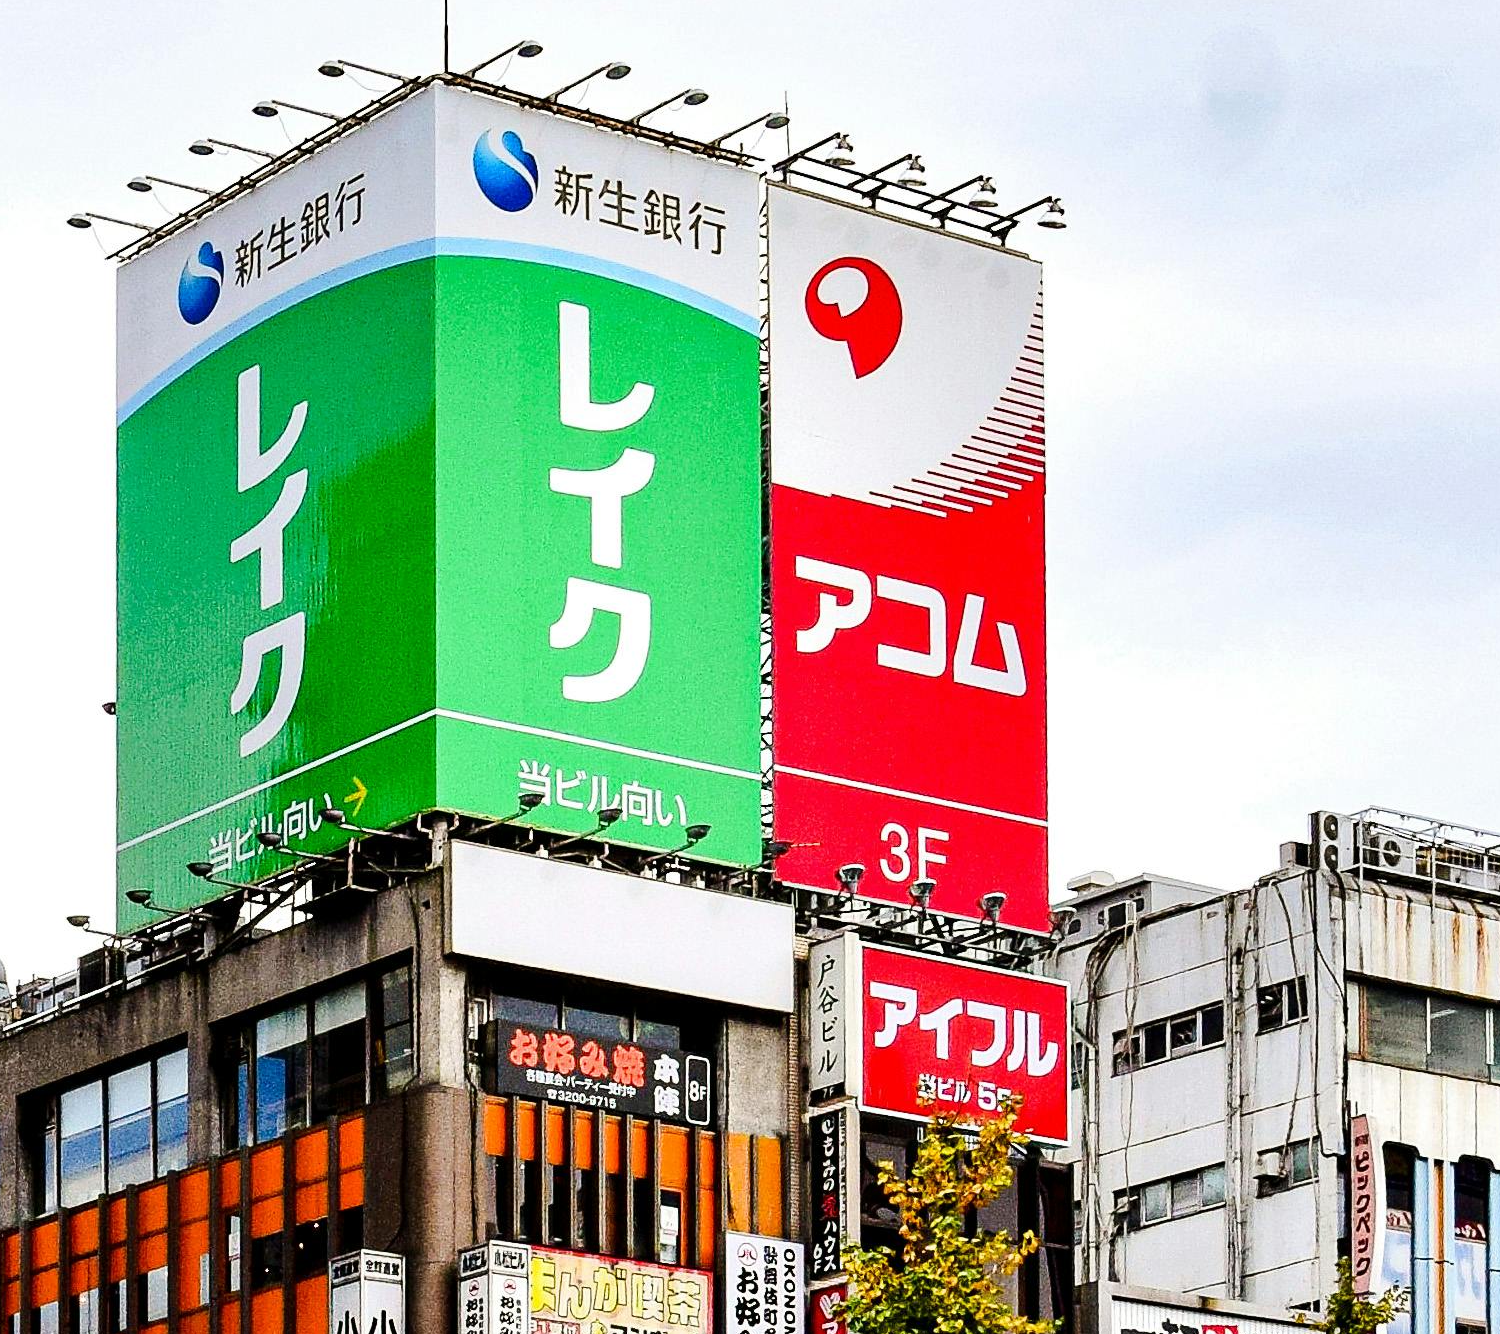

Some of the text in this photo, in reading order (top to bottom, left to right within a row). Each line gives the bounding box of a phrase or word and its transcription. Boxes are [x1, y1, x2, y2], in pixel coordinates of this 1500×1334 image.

[233, 172, 368, 285] 新生銀行
[554, 165, 729, 258] 新生銀行
[548, 301, 657, 703] レイク
[229, 363, 309, 758] レイク
[796, 557, 1028, 697] アコム
[517, 761, 687, 829] 当ビル向い
[878, 825, 949, 883] 3F
[818, 955, 838, 1075] 戸谷ビル
[869, 981, 1058, 1077] アイフル
[510, 1028, 680, 1116] お好み焼 本陣
[689, 1081, 706, 1101] 8F
